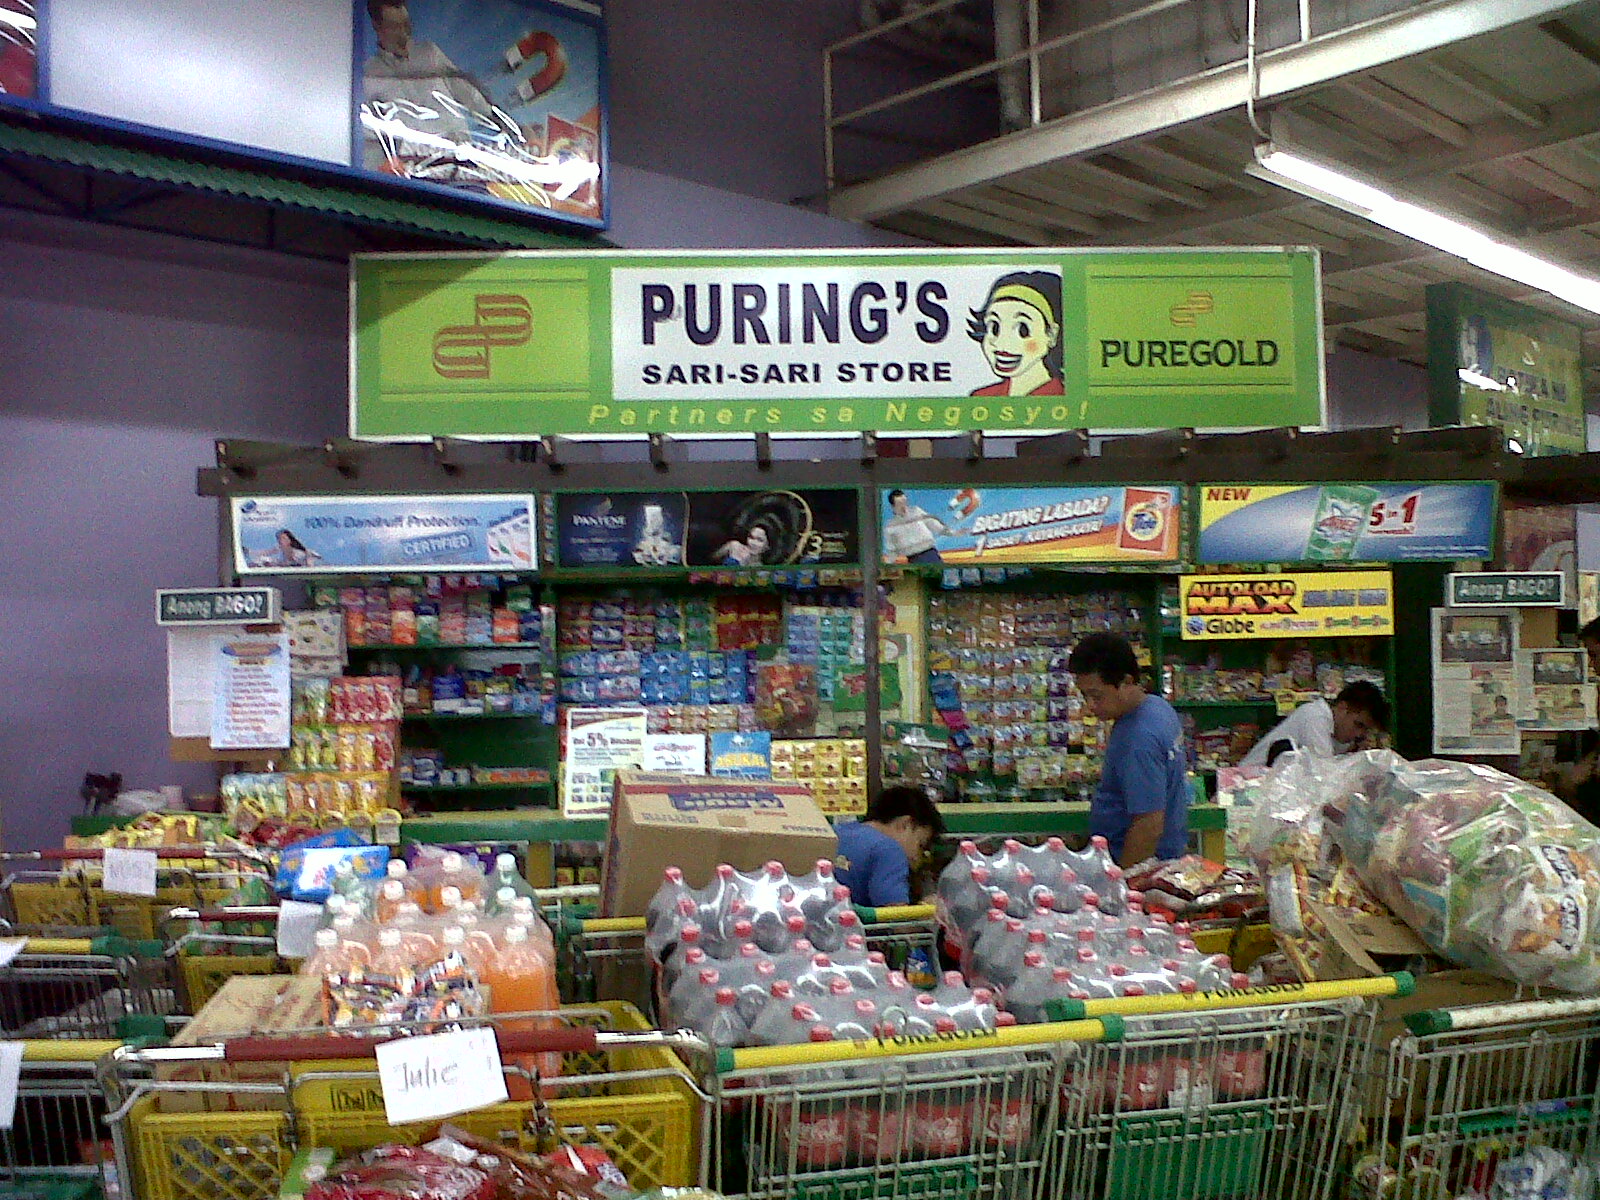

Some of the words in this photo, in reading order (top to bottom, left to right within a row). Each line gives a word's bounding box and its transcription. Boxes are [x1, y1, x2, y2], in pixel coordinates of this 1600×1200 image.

[640, 281, 949, 346] PURING'S
[1100, 339, 1279, 368] PUREGOLD
[642, 363, 821, 385] SARI-SARI
[838, 362, 952, 384] STORE
[588, 404, 782, 426] Partners
[811, 407, 854, 424] sa
[885, 401, 1089, 426] Negosyo!
[1206, 487, 1252, 501] NEW
[1401, 494, 1420, 524] 1
[1188, 580, 1296, 597] AUTOLOAD
[1187, 594, 1298, 616] MAX
[1206, 617, 1256, 634] Globe
[394, 1056, 458, 1092] Julie
